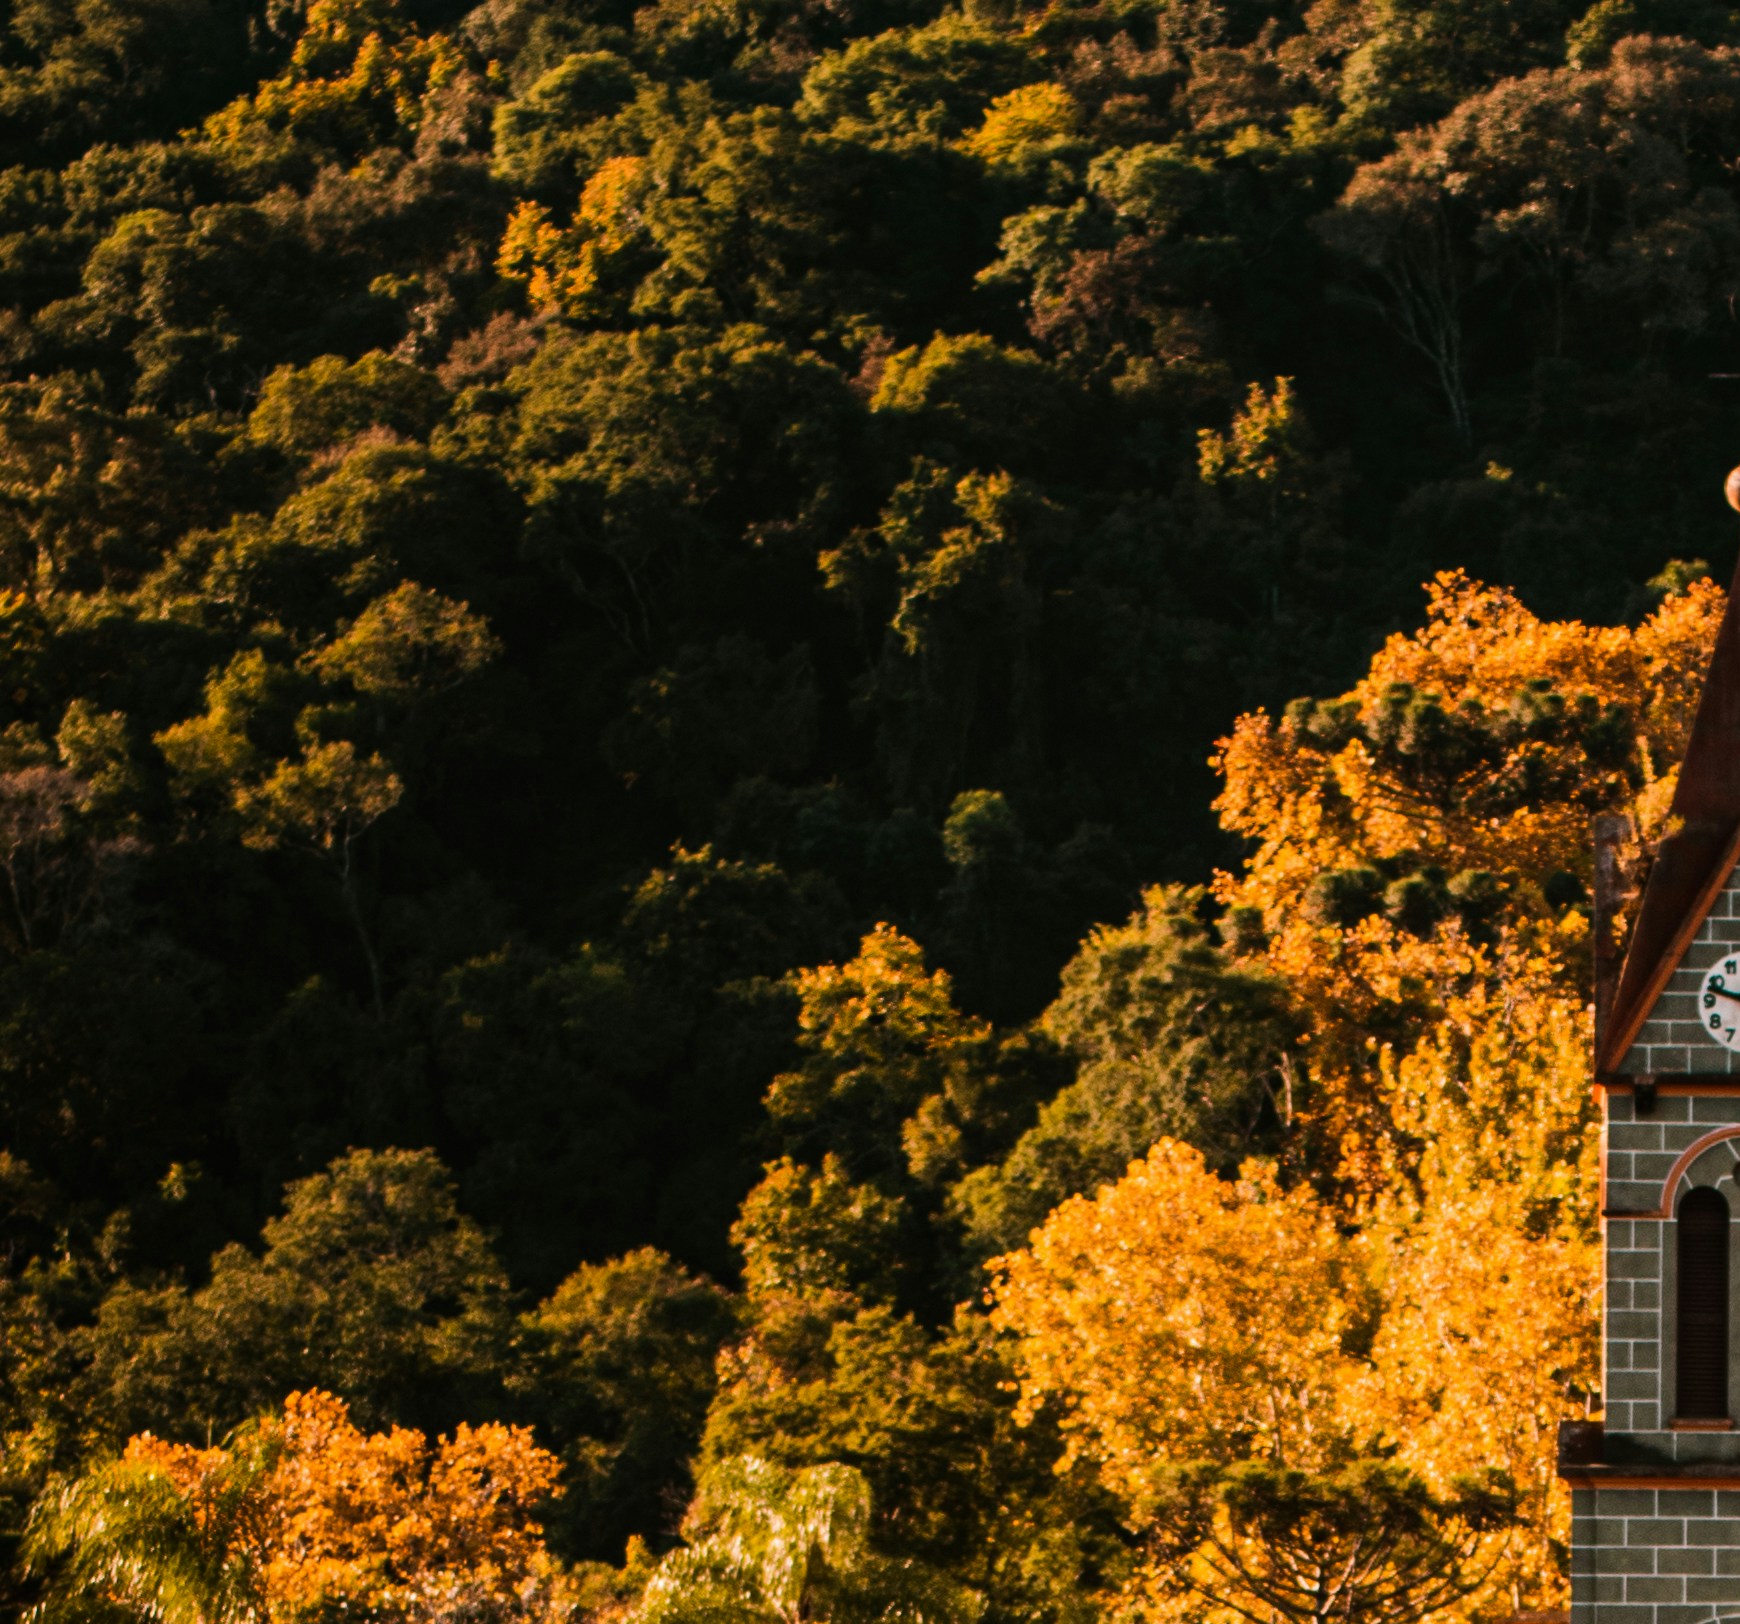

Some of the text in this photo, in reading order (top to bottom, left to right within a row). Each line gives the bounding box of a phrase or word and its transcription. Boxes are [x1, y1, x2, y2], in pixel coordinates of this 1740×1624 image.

[1724, 960, 1736, 974] 11
[1709, 974, 1724, 989] 10
[1704, 994, 1716, 1009] 9
[1710, 1013, 1721, 1029] 8
[1725, 1028, 1736, 1042] 7
